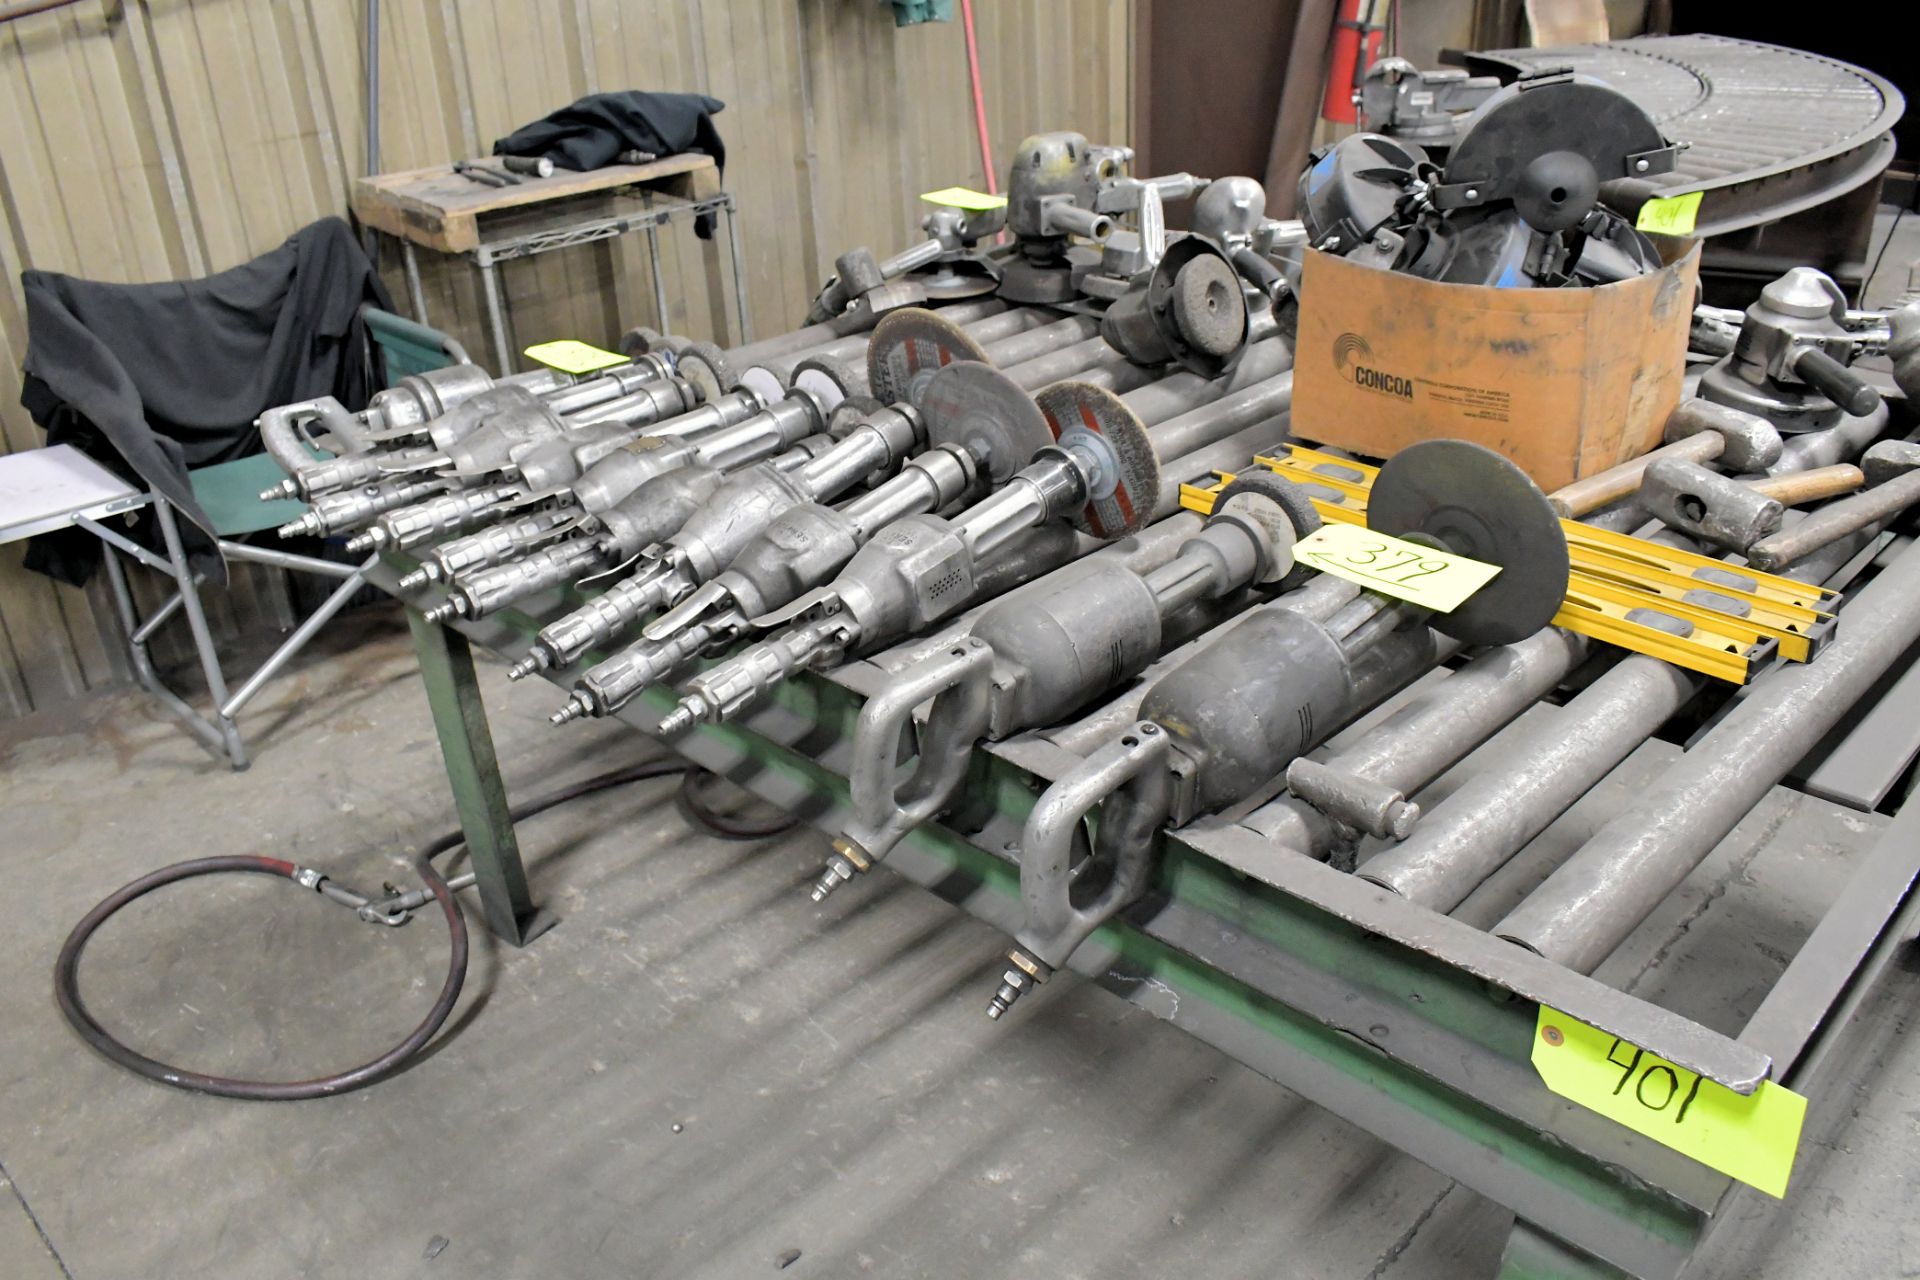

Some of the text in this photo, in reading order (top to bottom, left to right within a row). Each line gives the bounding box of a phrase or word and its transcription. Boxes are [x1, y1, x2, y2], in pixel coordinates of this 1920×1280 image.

[1356, 366, 1413, 399] CONCOA
[1346, 541, 1449, 582] 379
[1606, 1038, 1703, 1124] 401
